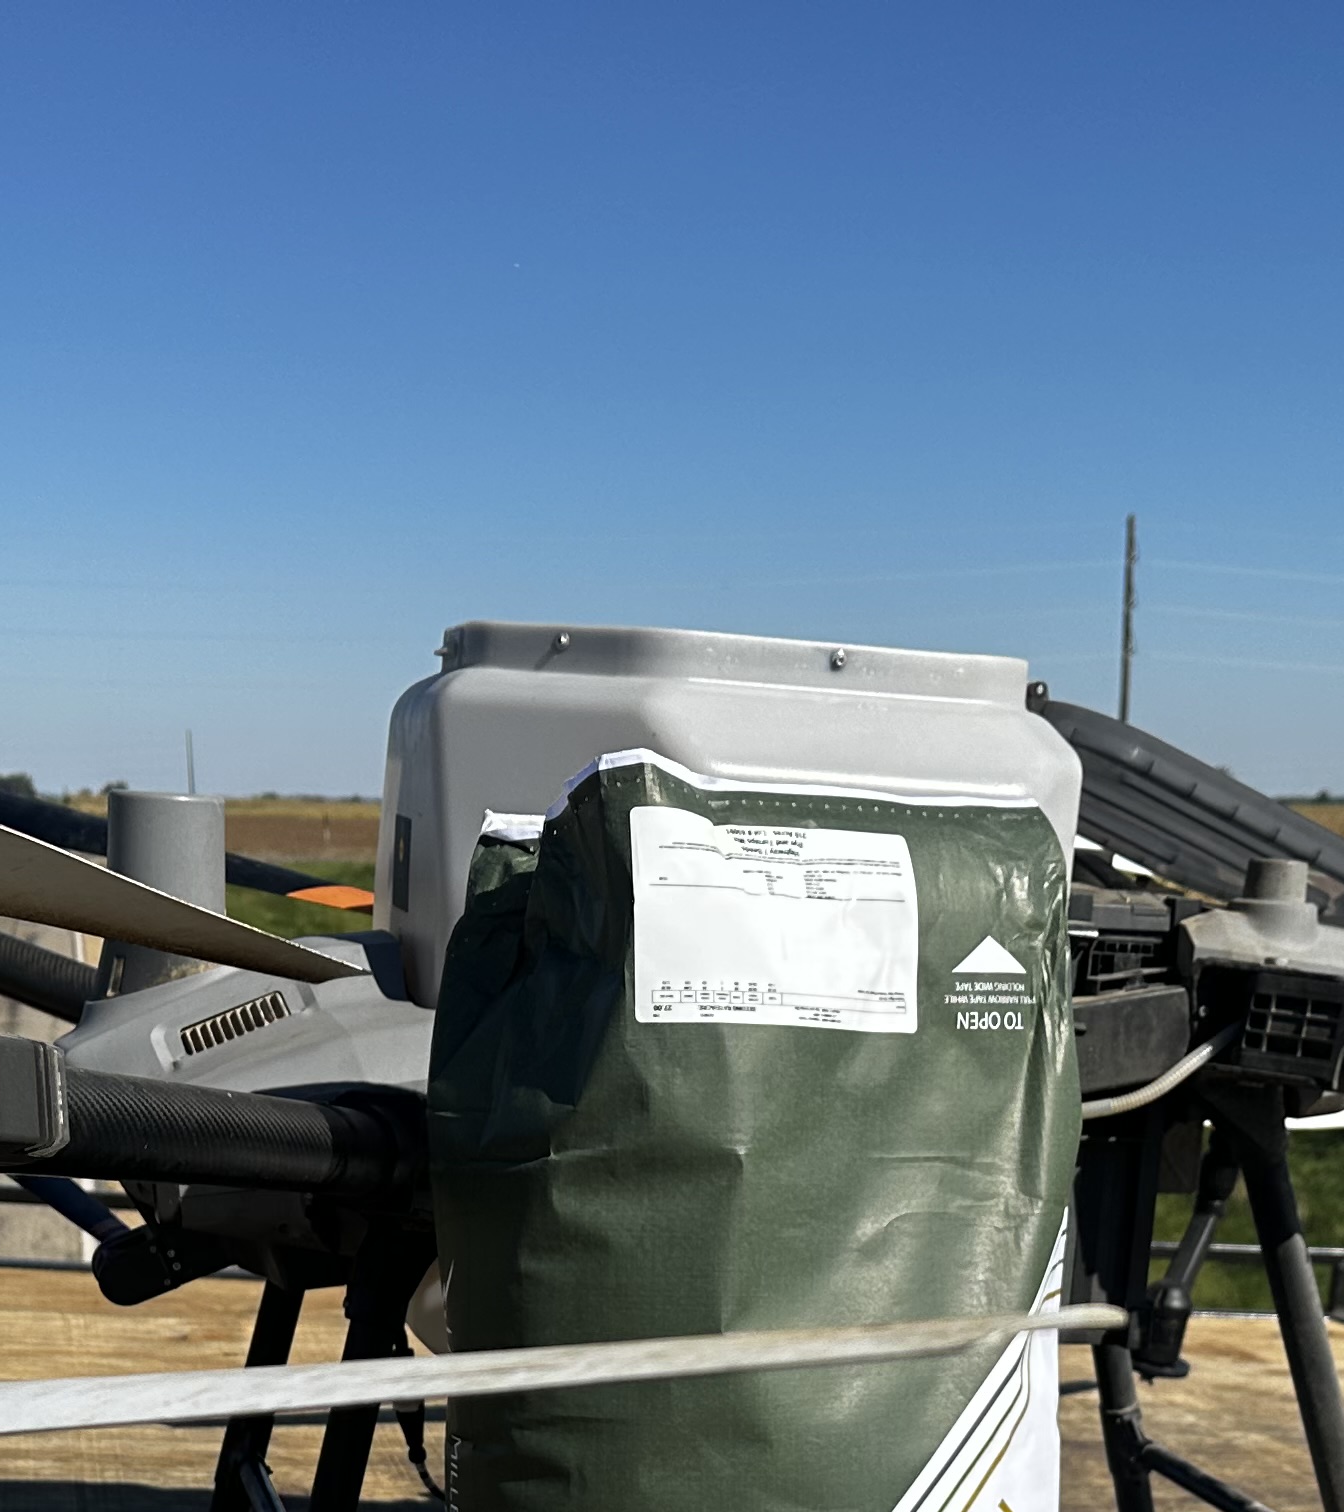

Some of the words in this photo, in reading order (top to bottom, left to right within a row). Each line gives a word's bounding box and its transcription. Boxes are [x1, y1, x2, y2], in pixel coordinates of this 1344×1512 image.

[955, 982, 973, 991] TAPE
[974, 982, 994, 991] WIDE
[994, 982, 1025, 992] HOLDING
[944, 994, 969, 1004] WHILE
[969, 994, 987, 1004] TAPE
[987, 995, 1019, 1005] NARROW
[956, 1011, 1001, 1030] OPEN
[1004, 1011, 1024, 1030] TO
